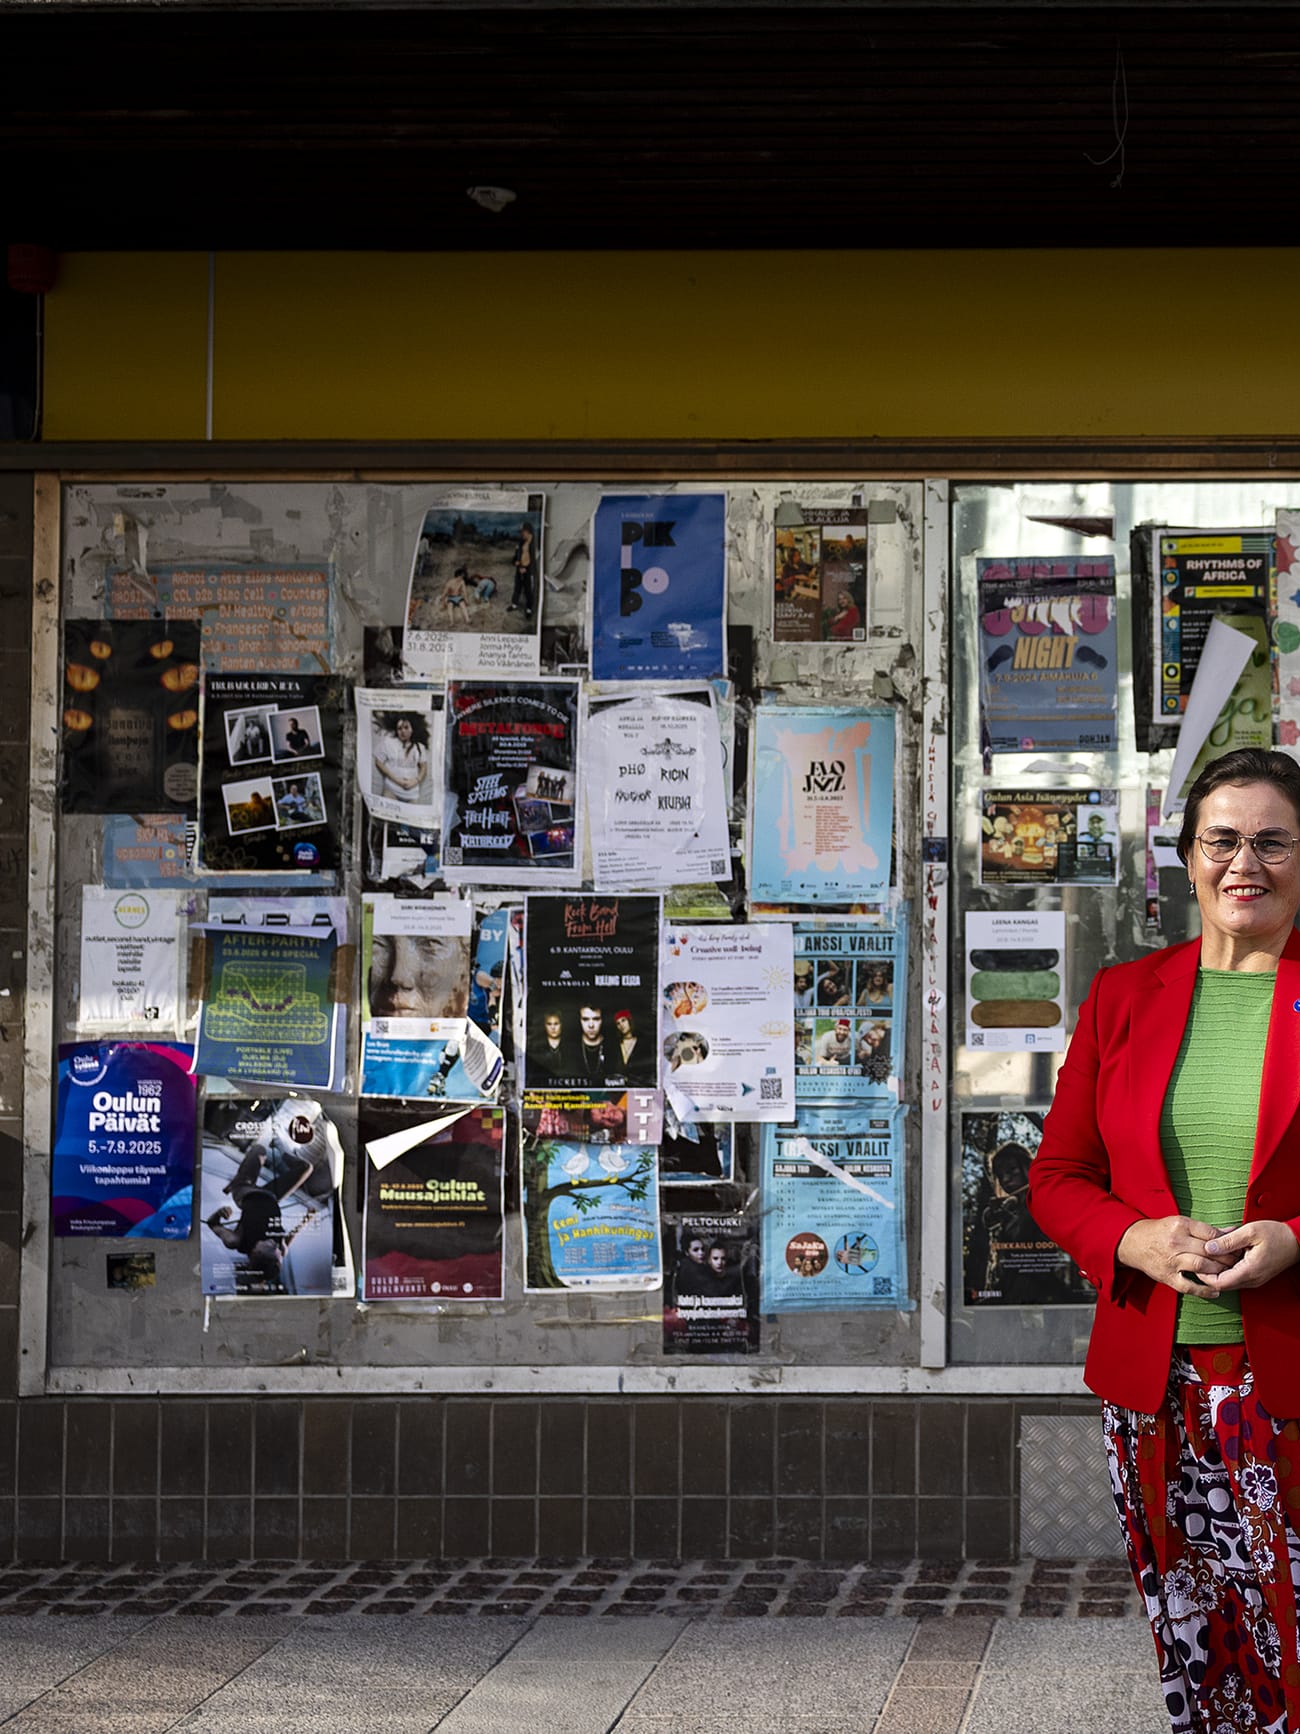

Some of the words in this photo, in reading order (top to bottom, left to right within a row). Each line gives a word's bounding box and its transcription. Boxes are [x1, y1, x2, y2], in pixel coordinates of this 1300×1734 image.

[1187, 559, 1244, 571] RHYTHMS
[1247, 560, 1262, 570] OF
[1203, 570, 1247, 581] AFRICA
[1014, 636, 1079, 670] NIGHT
[92, 1092, 161, 1113] Oulun
[89, 1111, 161, 1133] Päivät
[79, 1164, 134, 1176] Viikonloppu
[136, 1164, 166, 1176] täynnä
[94, 1175, 150, 1186] tapahtumia!
[425, 1179, 478, 1192] Oulun
[380, 1188, 486, 1204] Muusajuhlat
[682, 1217, 742, 1227] PELTOKURKI
